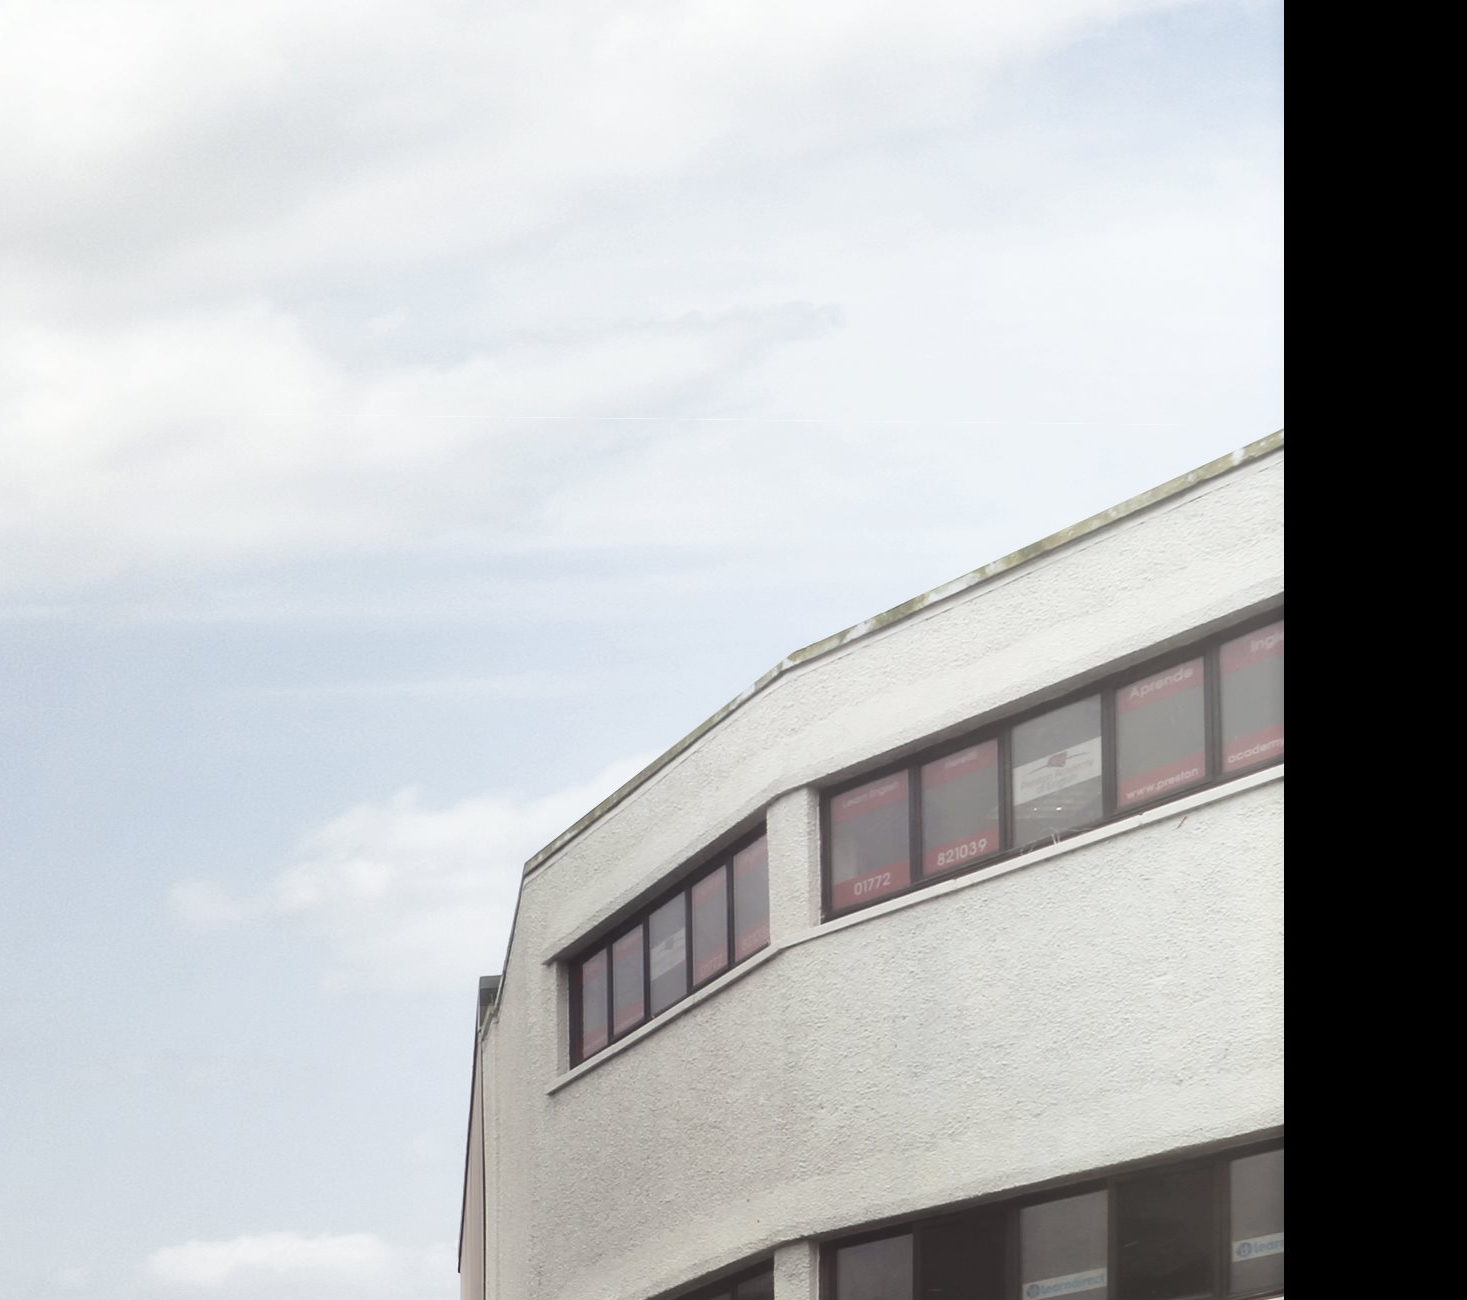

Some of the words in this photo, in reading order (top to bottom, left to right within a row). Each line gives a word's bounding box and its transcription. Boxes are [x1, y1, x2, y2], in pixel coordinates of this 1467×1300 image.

[1129, 667, 1193, 701] Aprende
[937, 838, 987, 866] 821039
[854, 872, 891, 896] 01772
